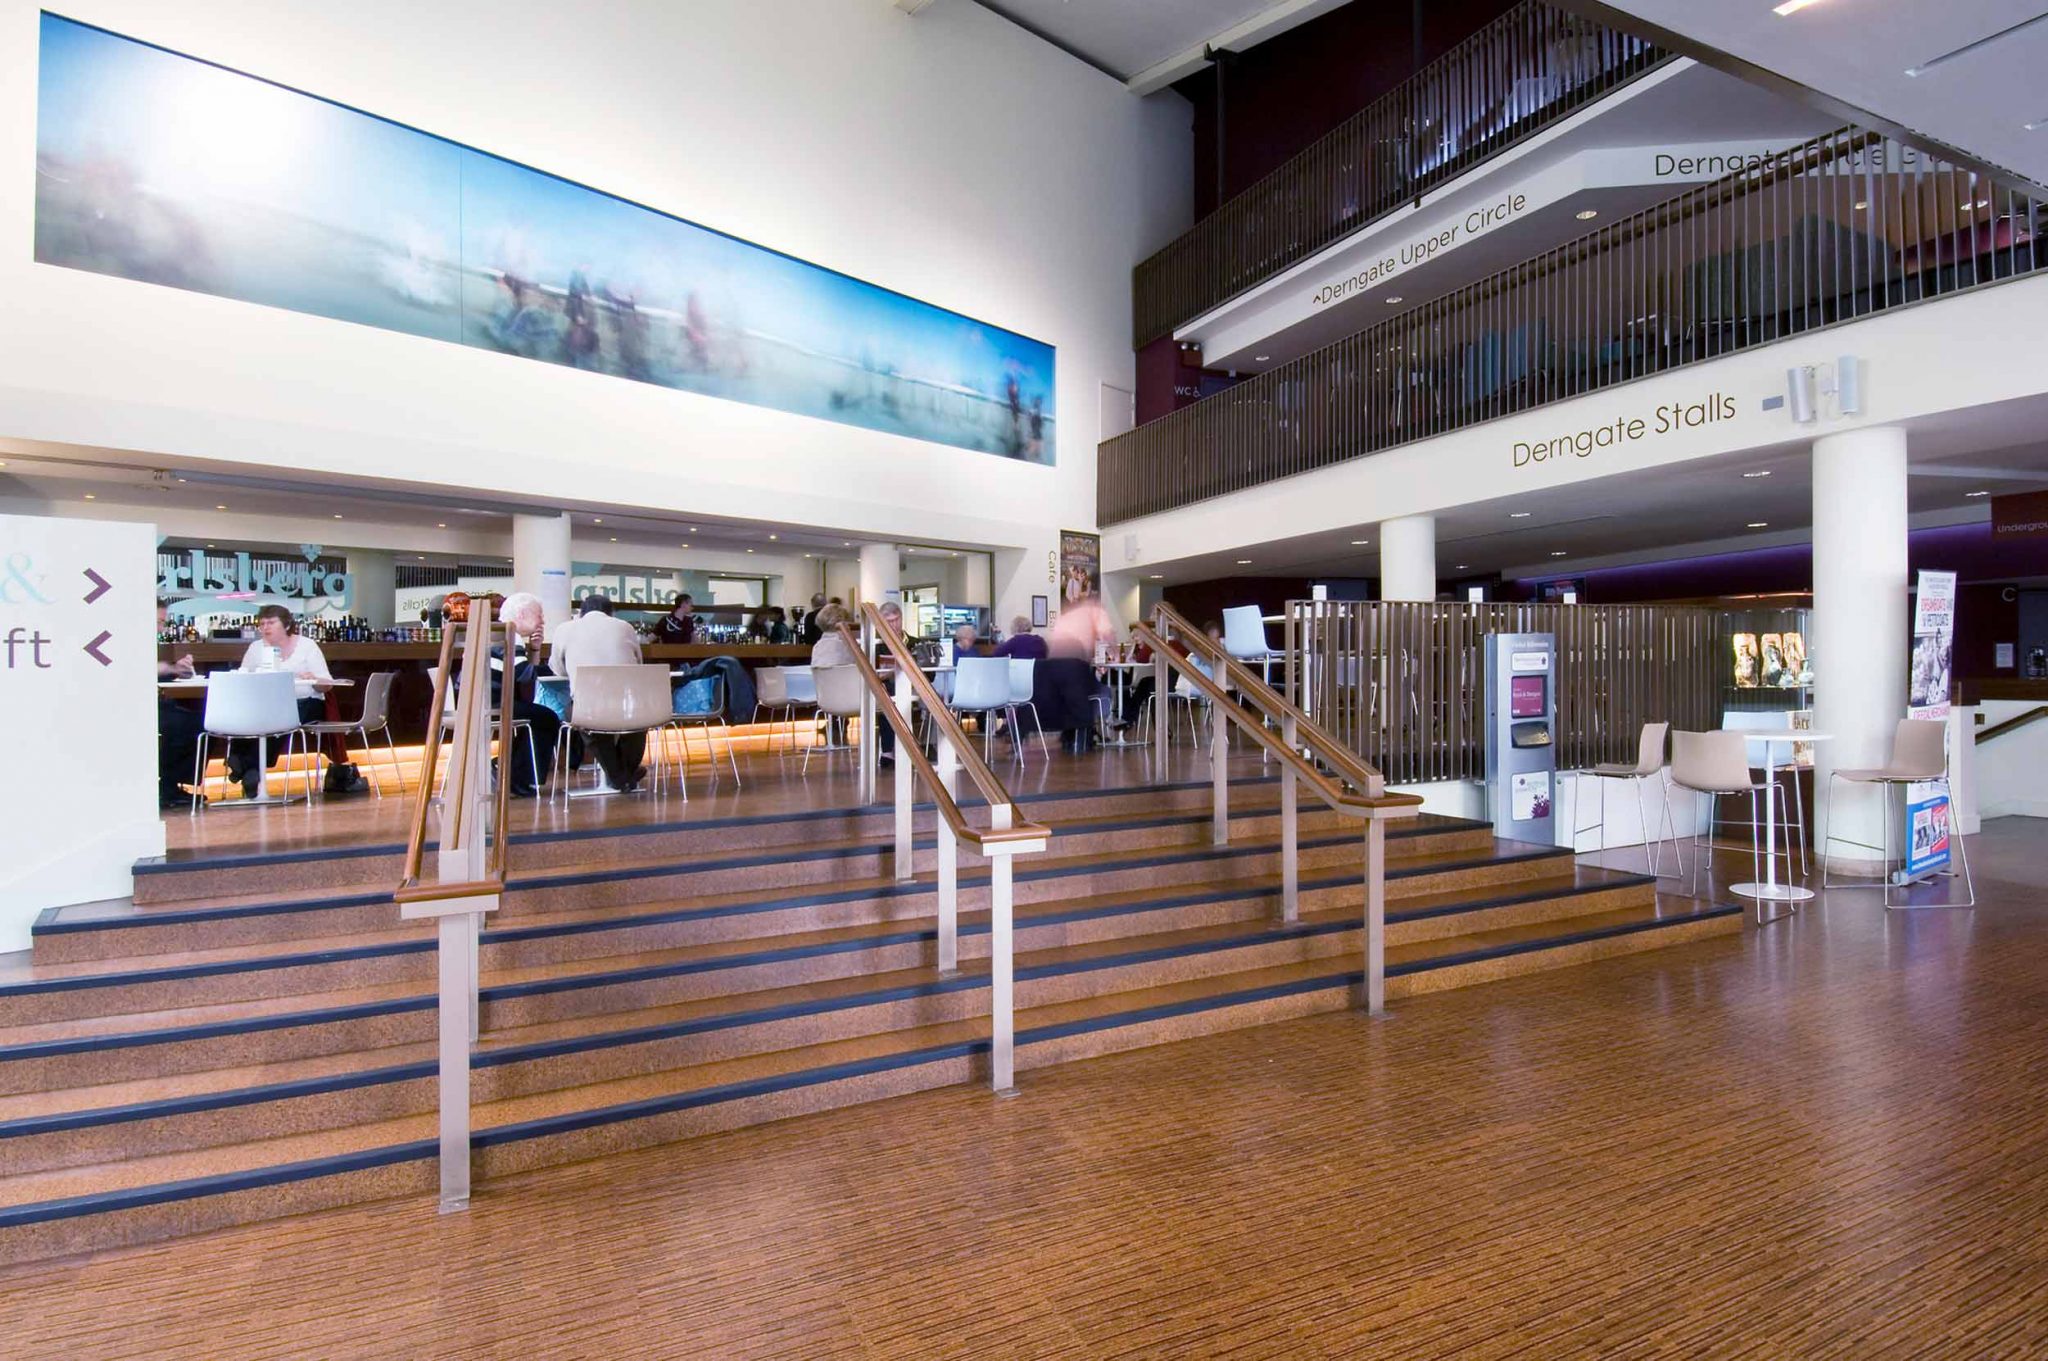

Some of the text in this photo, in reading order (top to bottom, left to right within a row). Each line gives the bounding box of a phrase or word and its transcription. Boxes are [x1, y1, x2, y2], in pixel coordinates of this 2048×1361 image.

[1322, 194, 1526, 304] Derngate Upper Circle
[1174, 385, 1192, 396] WC
[1513, 392, 1737, 468] Derngate Stalls
[157, 549, 357, 612] rlsberg
[2, 627, 52, 669] ft
